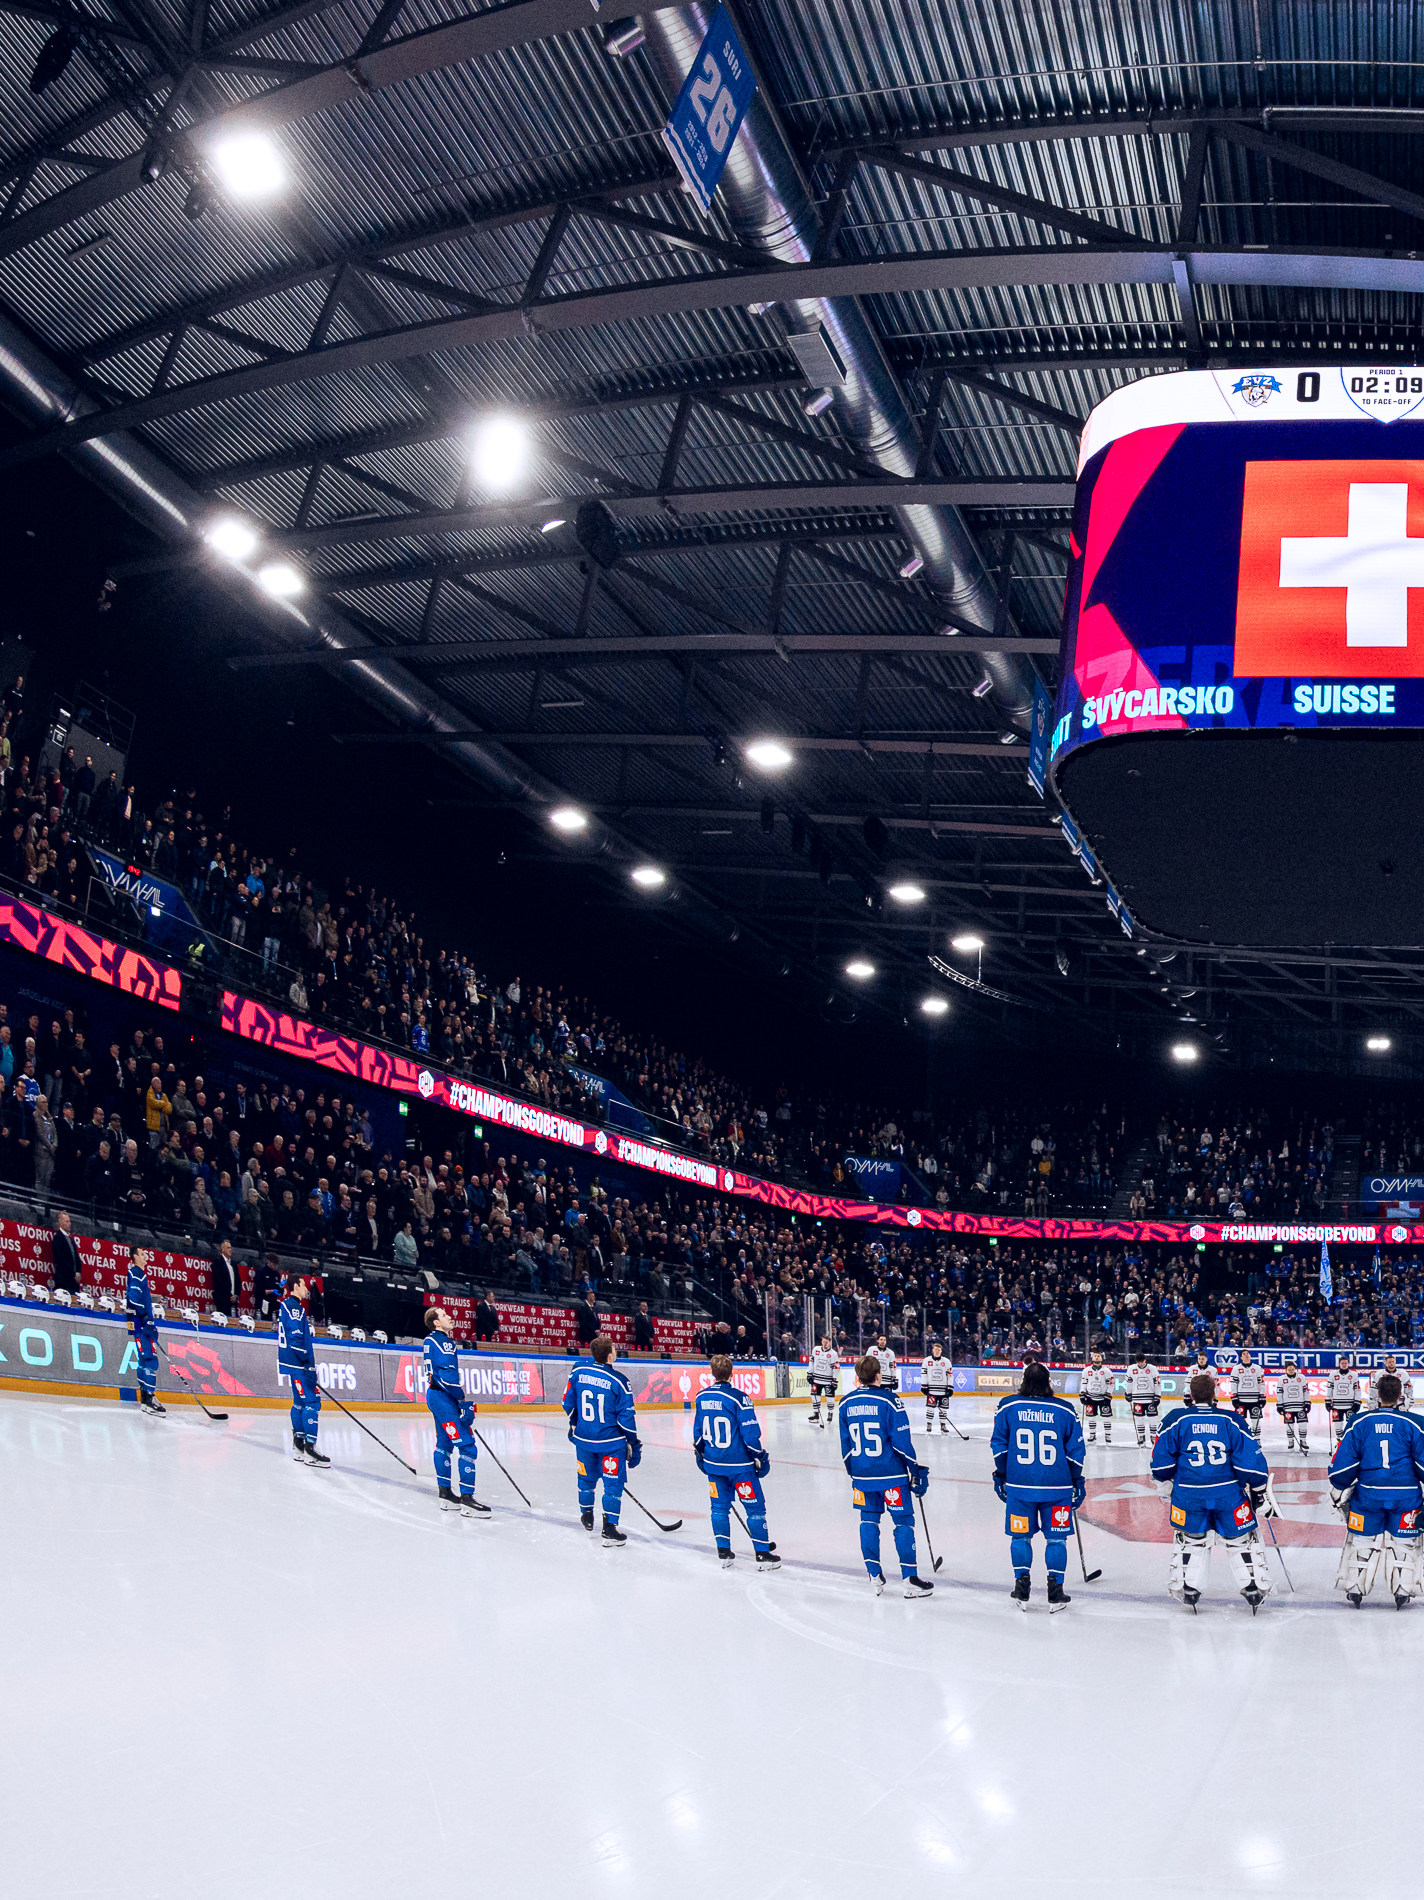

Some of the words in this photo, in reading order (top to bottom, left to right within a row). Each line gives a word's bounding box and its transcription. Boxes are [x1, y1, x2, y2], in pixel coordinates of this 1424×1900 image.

[722, 41, 742, 80] SURI
[689, 52, 737, 154] 26
[1240, 375, 1273, 387] EVZ
[1296, 372, 1321, 403] 0
[1351, 377, 1423, 393] 02:09
[1082, 686, 1235, 729] ŠVÝCARSKO
[1294, 685, 1395, 714] SUISSE
[450, 1081, 585, 1147] #CHAMPIONSGOBEYOND
[617, 1138, 717, 1186] #CHAMPIONSGOBEYOND
[1191, 1227, 1205, 1238] CHL
[1221, 1225, 1376, 1241] #CHAMPIONSGOBEYOND
[1393, 1229, 1407, 1239] CHL
[184, 1257, 213, 1272] WORK
[147, 1265, 188, 1282] STRAUSS
[443, 1296, 470, 1308] STRAUSS
[541, 1307, 566, 1318] STRAUSS
[510, 1314, 545, 1326] WORKWEAR
[657, 1319, 683, 1328] WORKWEAR
[542, 1327, 567, 1337] STRAUSS
[657, 1336, 684, 1345] WORKWEAR
[1216, 1354, 1238, 1364] EVZ
[980, 1376, 1002, 1385] Giti
[1136, 1376, 1150, 1390] S
[1242, 1375, 1255, 1389] S
[1288, 1385, 1301, 1399] S
[1336, 1382, 1350, 1396] S
[581, 1389, 606, 1423] 61
[1018, 1408, 1054, 1424] VOŽENÍLEK
[702, 1415, 731, 1448] 40
[1192, 1423, 1218, 1435] GENONI
[1375, 1423, 1393, 1434] WOLF
[849, 1422, 882, 1457] 95
[1016, 1428, 1057, 1466] 96
[1379, 1439, 1391, 1470] 1
